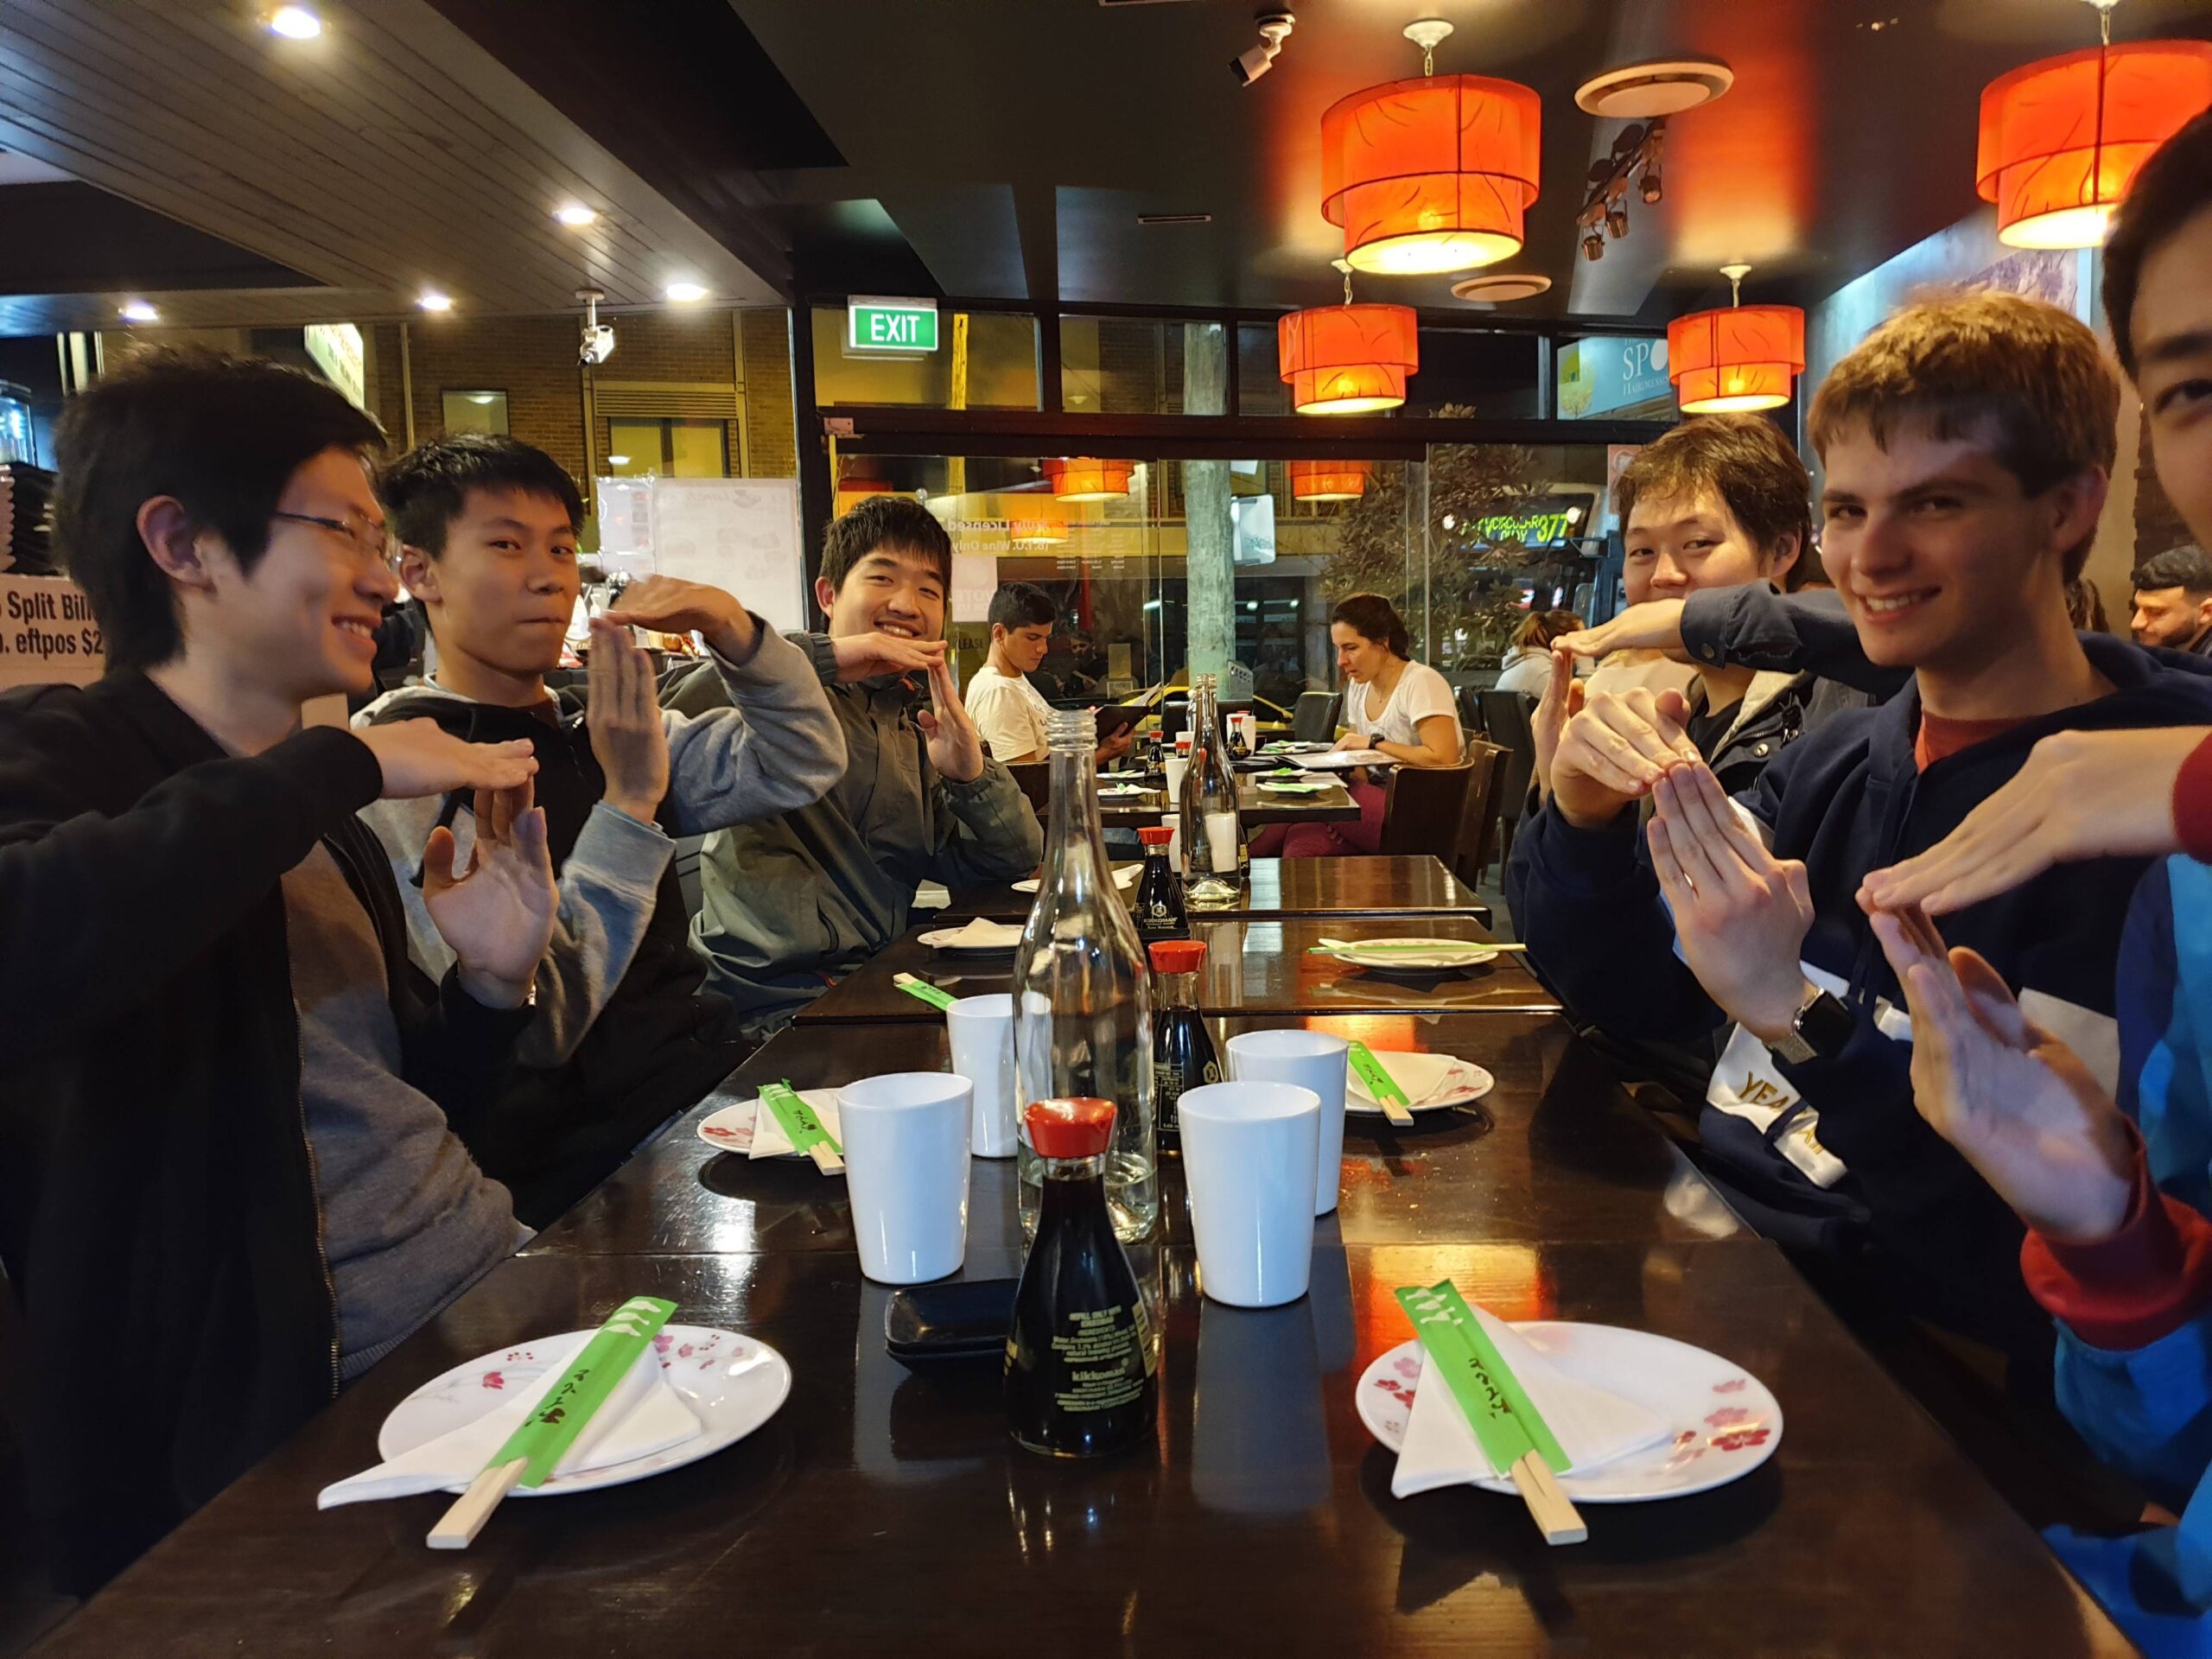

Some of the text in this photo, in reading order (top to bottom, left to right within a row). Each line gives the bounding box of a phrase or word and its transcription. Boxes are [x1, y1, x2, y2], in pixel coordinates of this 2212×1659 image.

[870, 313, 920, 343] EXIT
[1536, 513, 1567, 543] 377
[7, 590, 57, 625] Split
[16, 627, 77, 660] eftpos
[1738, 1071, 1790, 1109] YEA
